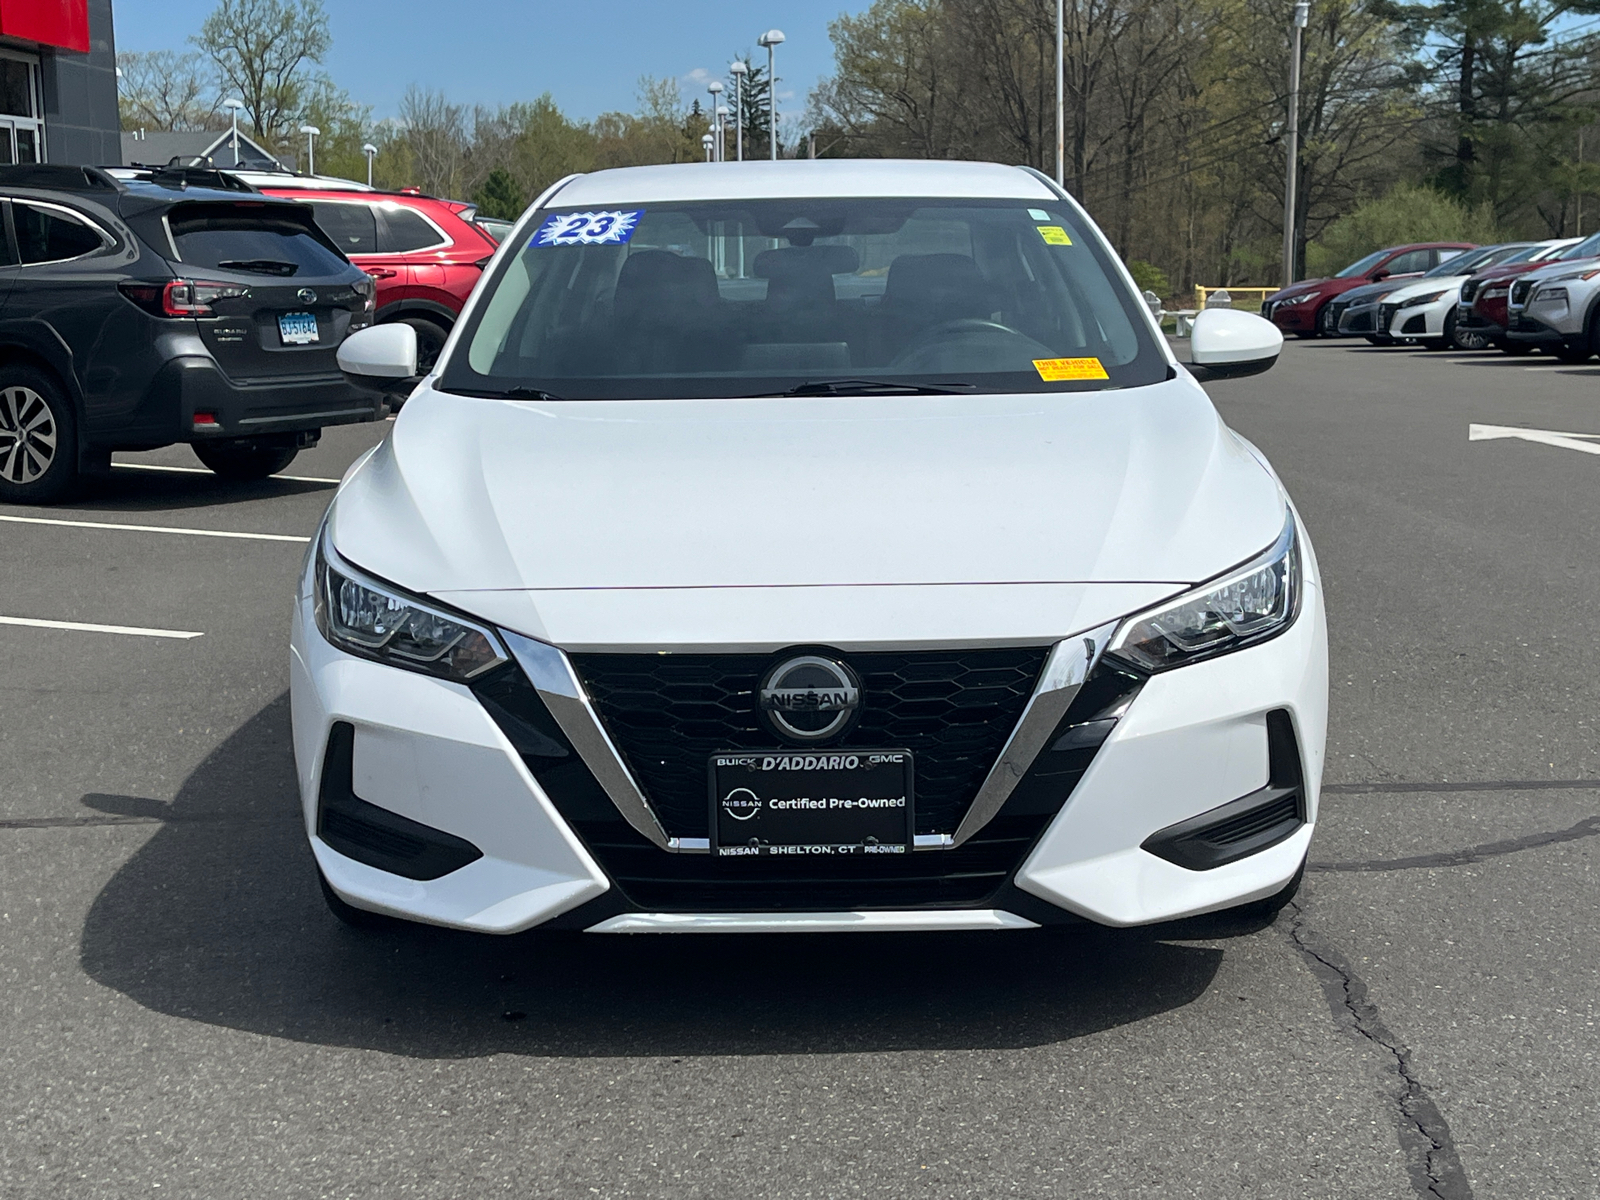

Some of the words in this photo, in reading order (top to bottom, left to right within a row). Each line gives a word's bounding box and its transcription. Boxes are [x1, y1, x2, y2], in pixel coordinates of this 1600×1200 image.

[557, 216, 615, 238] 23
[770, 691, 848, 706] NISSAN
[717, 758, 756, 767] BUICK
[762, 755, 859, 771] D'ADDARIO
[869, 755, 904, 764] GMC
[769, 798, 827, 810] Certified
[829, 796, 906, 809] Pre-Owned
[719, 847, 760, 856] NISSAN
[769, 846, 835, 855] SHELTON,
[838, 846, 857, 854] CT
[864, 845, 906, 854] PRE-OWNED
